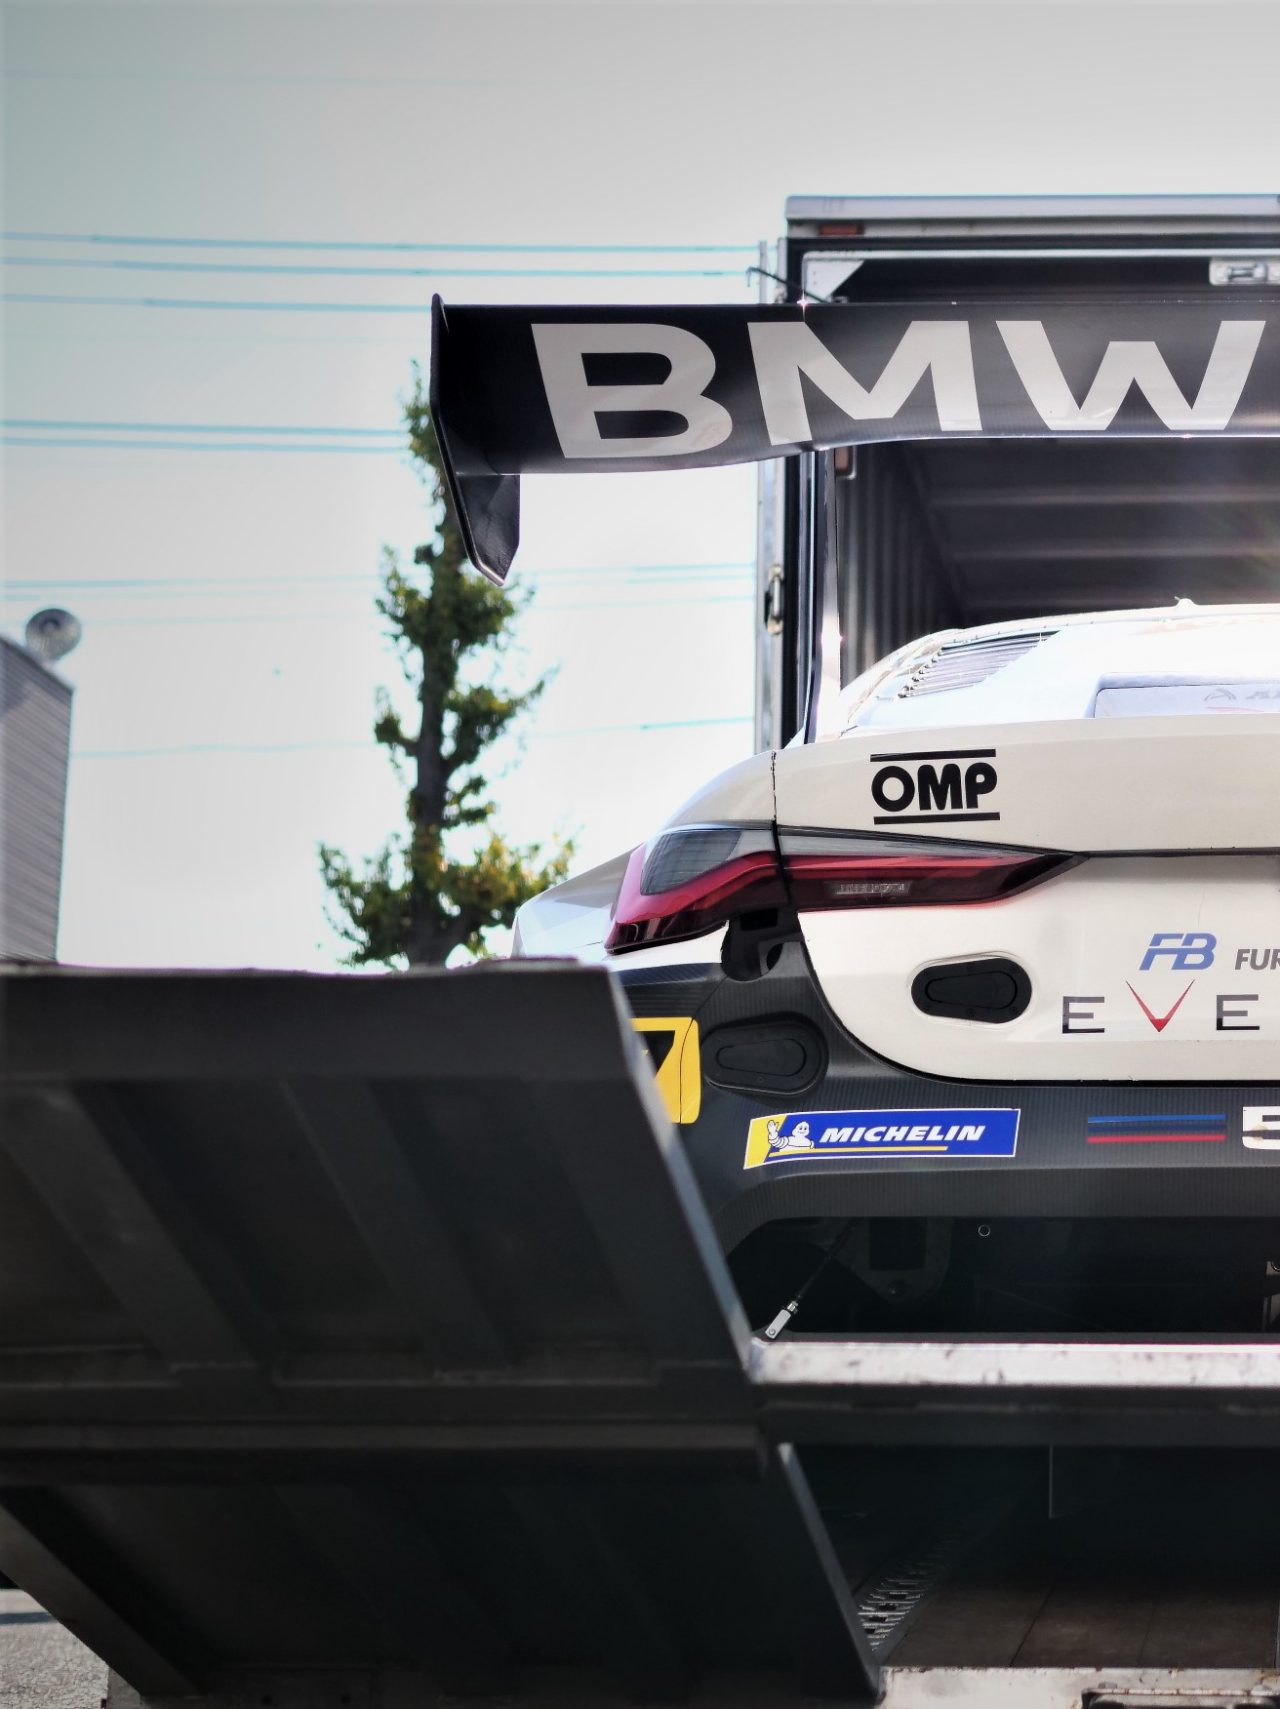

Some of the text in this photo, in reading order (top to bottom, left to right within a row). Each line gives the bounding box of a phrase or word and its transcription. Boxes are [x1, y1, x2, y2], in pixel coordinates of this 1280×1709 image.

[531, 320, 1267, 459] BMW
[871, 762, 998, 812] OMP
[1139, 933, 1217, 970] FB
[819, 1124, 986, 1144] MICHELIN
